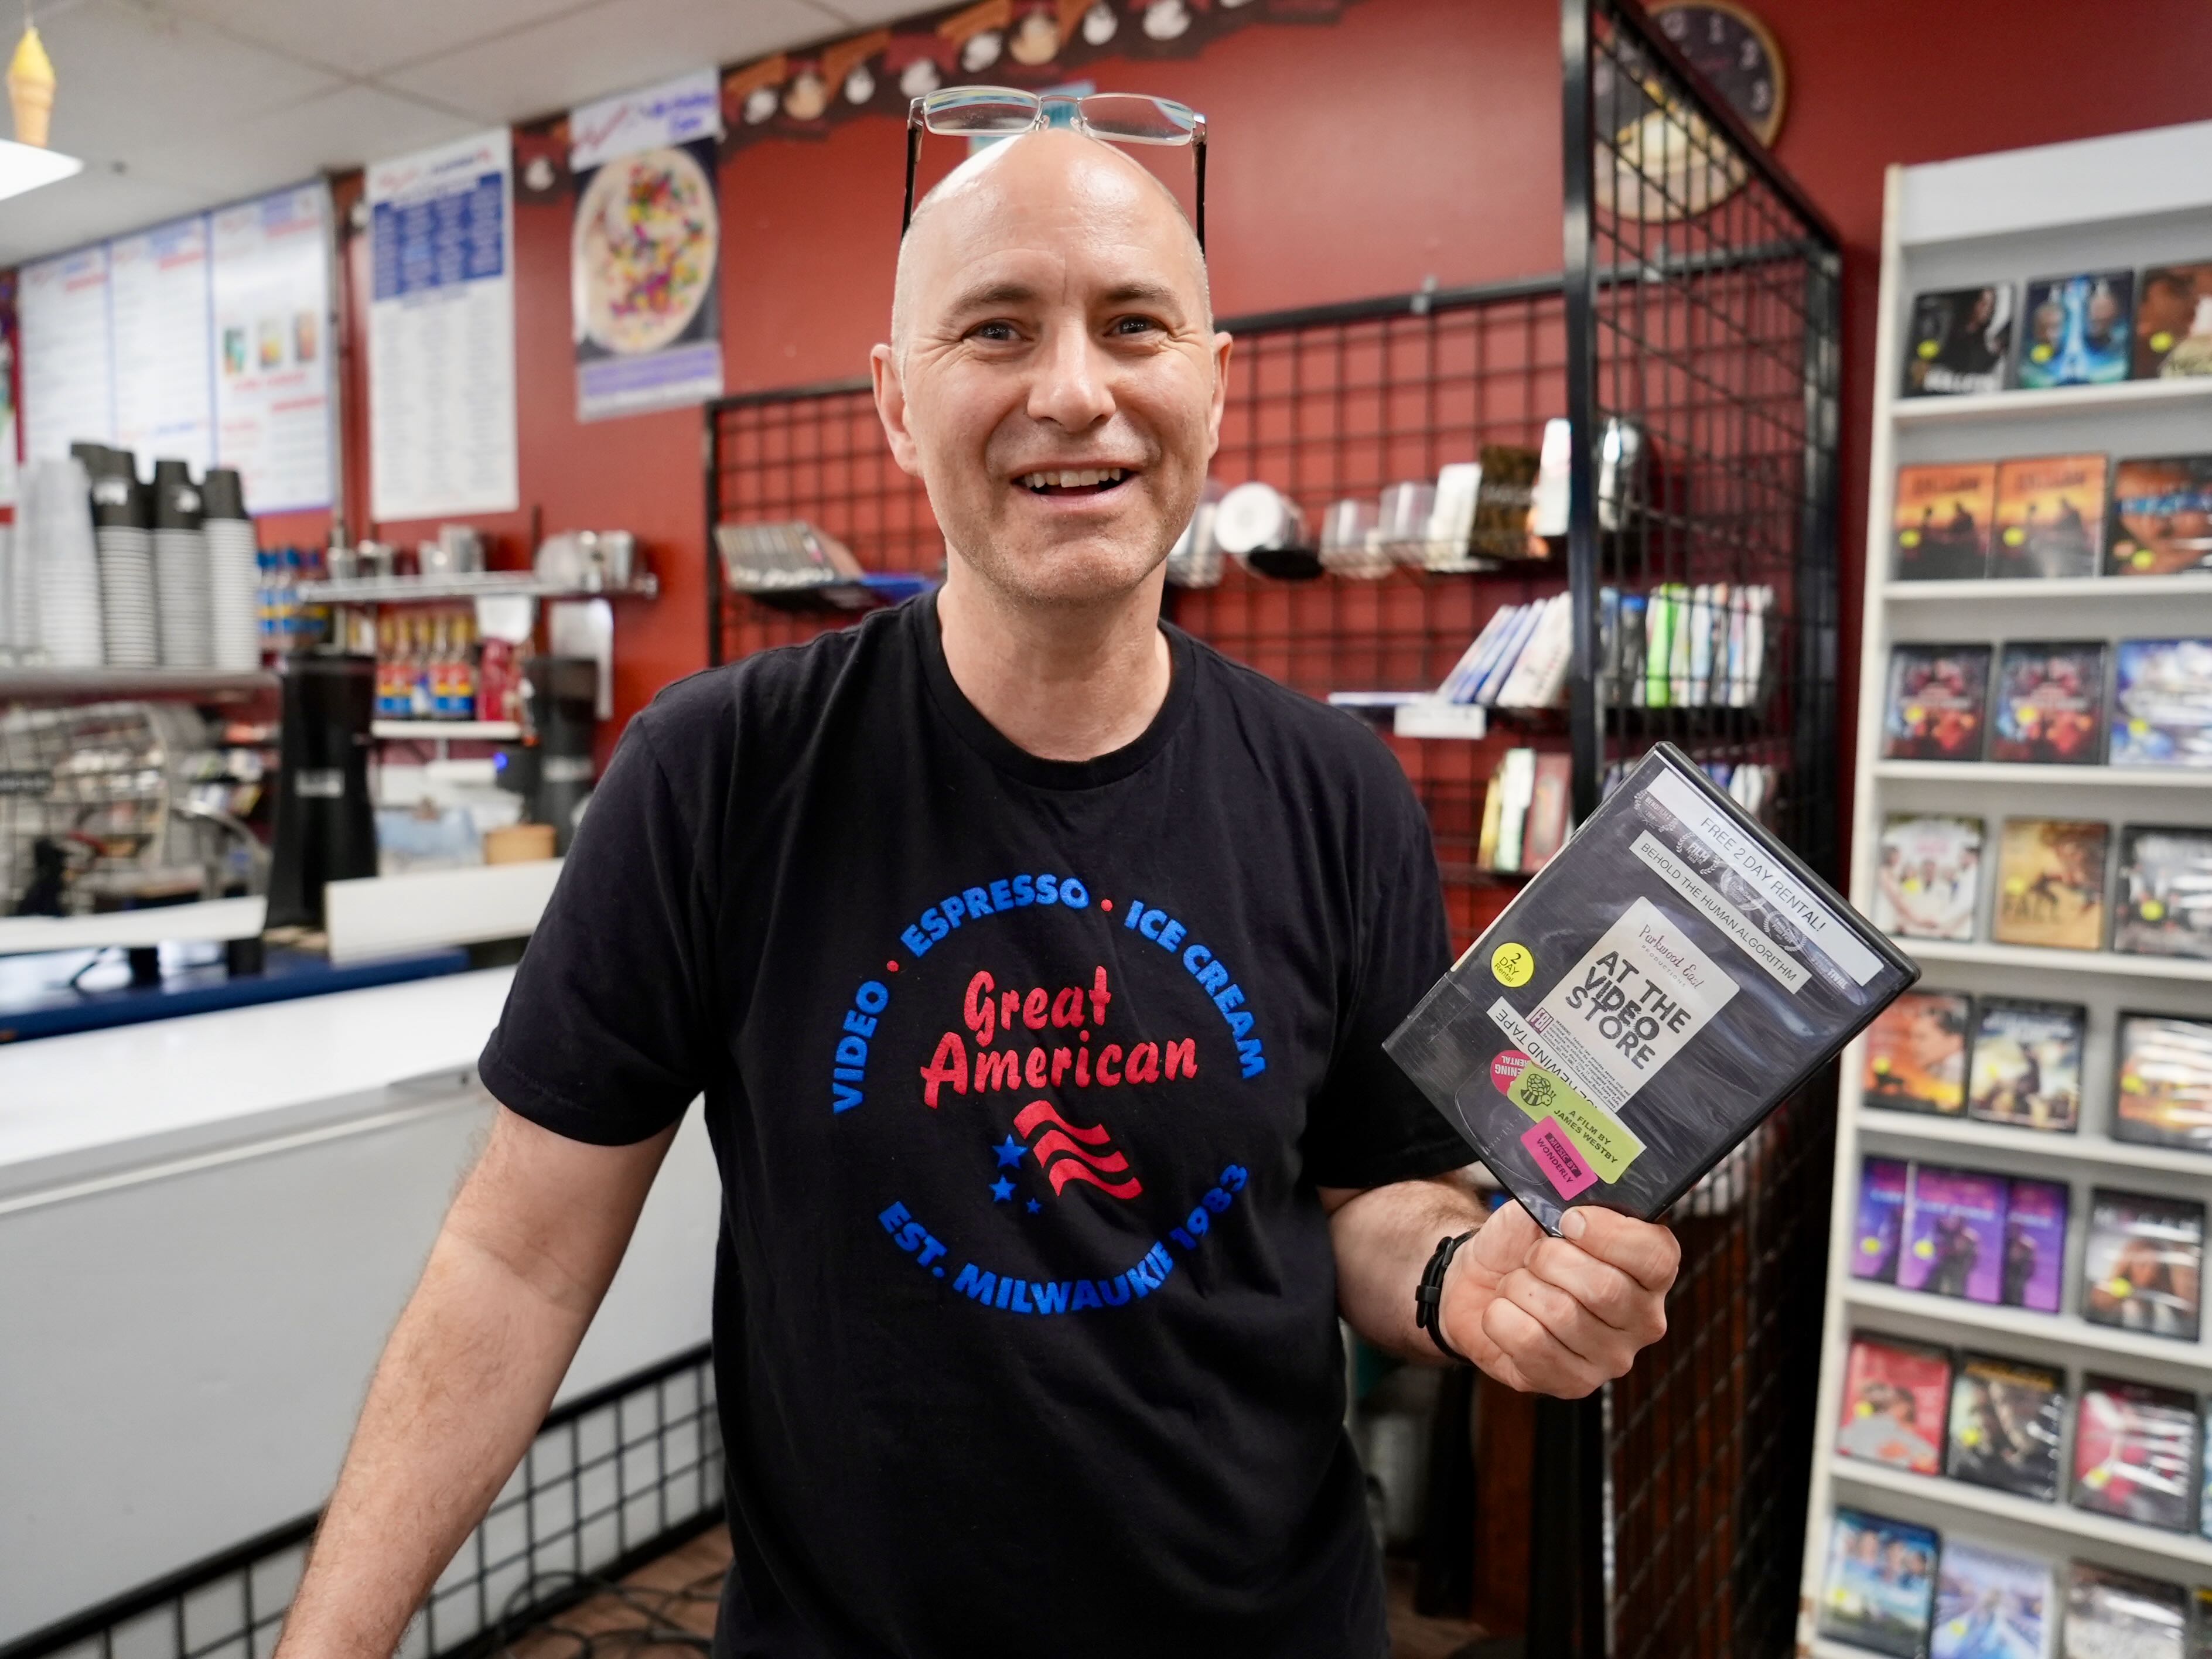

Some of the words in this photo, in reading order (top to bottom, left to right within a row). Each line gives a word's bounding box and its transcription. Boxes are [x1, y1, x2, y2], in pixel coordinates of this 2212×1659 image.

[1688, 841, 1711, 863] FILM
[1700, 817, 1737, 852] FREE
[1733, 846, 1746, 860] 2
[1742, 855, 1773, 885] DAY
[1770, 879, 1826, 933] RENTAL!
[1640, 842, 1682, 880] BEHOLD
[1679, 876, 1702, 899] THE
[1700, 895, 1738, 930] HUMAN
[1735, 926, 1797, 981] ALGORITHM
[1498, 956, 1520, 977] DAY
[1510, 951, 1522, 964] 2
[1638, 924, 1685, 968] Parkwood
[1640, 944, 1687, 988] PRODUCTIONS
[831, 980, 890, 1114] VIDEO
[900, 873, 1091, 958] ESPRESSO
[1125, 900, 1188, 954] ICE
[1183, 943, 1268, 1079] CREAM
[1493, 962, 1514, 983] Rental
[1595, 950, 1640, 984] AT
[1639, 978, 1692, 1035] THE
[964, 965, 1112, 1047] Great
[1495, 1008, 1530, 1045] TAPE
[1530, 1008, 1554, 1032] FBI
[1583, 966, 1660, 1042] VIDEO
[1565, 985, 1657, 1070] STORE
[920, 1030, 1198, 1109] American
[1553, 1108, 1582, 1134] JAMES
[1582, 1132, 1618, 1165] WESTBY
[1568, 1109, 1577, 1118] A
[1576, 1115, 1597, 1135] FILM
[1597, 1133, 1611, 1146] BY
[1536, 1138, 1573, 1184] WONDERLY
[1548, 1136, 1569, 1162] MUSIC
[1566, 1160, 1578, 1172] BY
[878, 1200, 948, 1278] EST.
[953, 1240, 1175, 1316] MILWAUKIE
[1170, 1163, 1249, 1251] 1983
